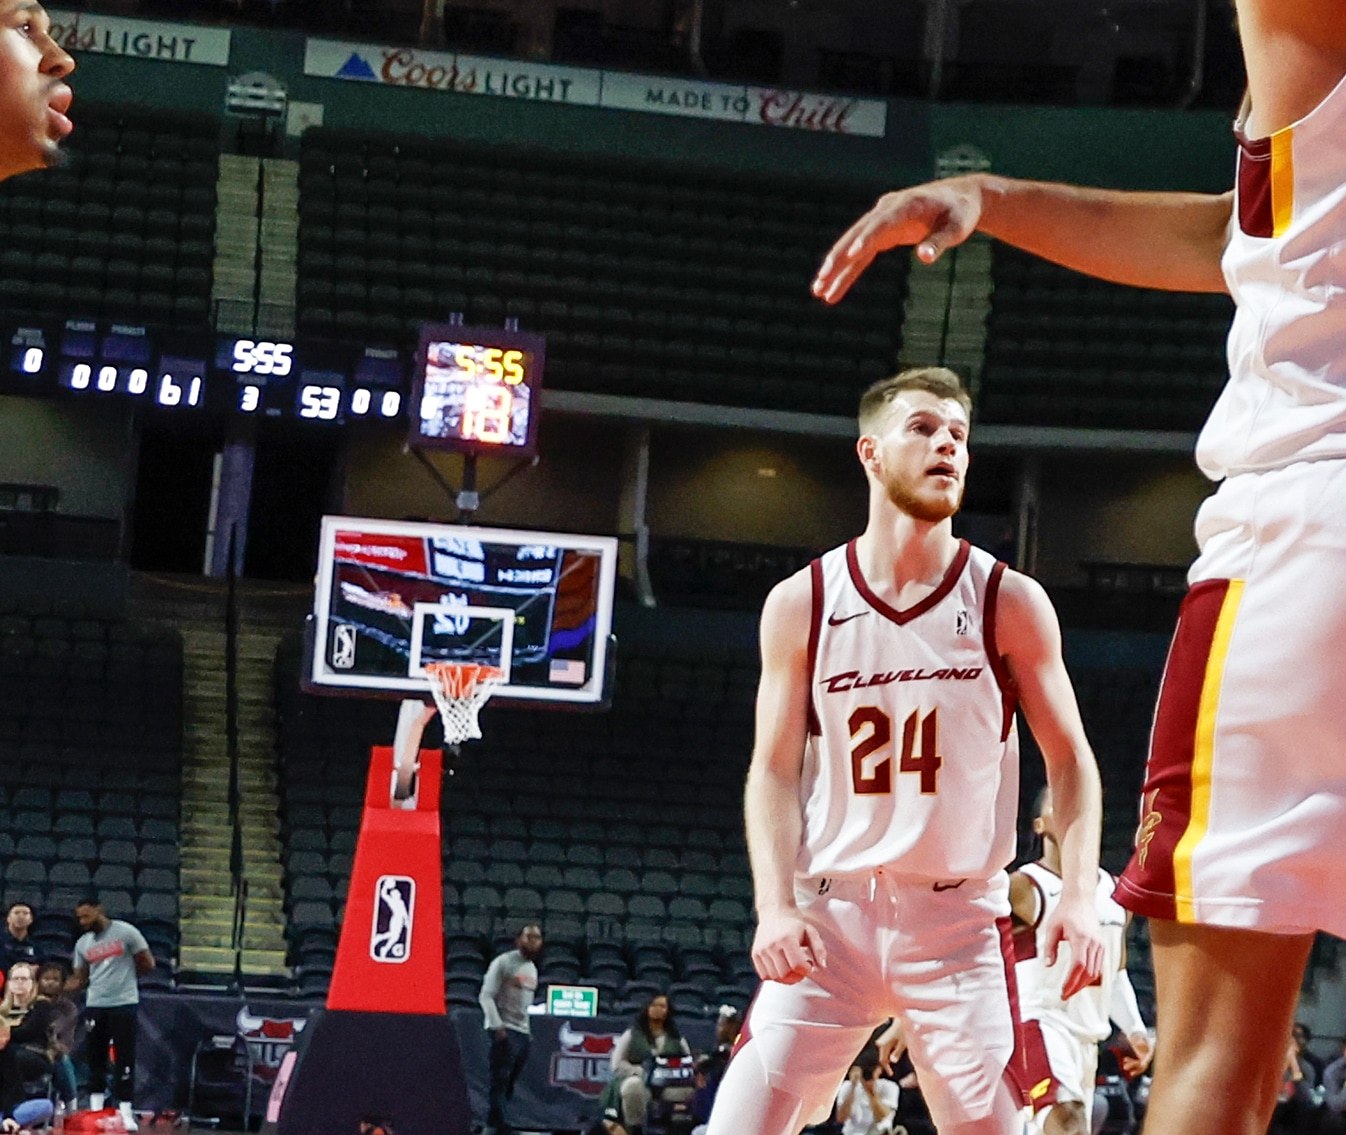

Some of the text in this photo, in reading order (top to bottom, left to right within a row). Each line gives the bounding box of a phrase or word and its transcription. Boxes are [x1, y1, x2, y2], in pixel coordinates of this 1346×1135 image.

[104, 30, 196, 60] LIGHT
[381, 48, 574, 101] Coors LIGHT
[647, 88, 857, 133] MADE TO Chill
[455, 344, 524, 385] 5:55
[300, 385, 341, 420] 53
[819, 667, 984, 694] CLEVELAND
[847, 704, 943, 796] 24
